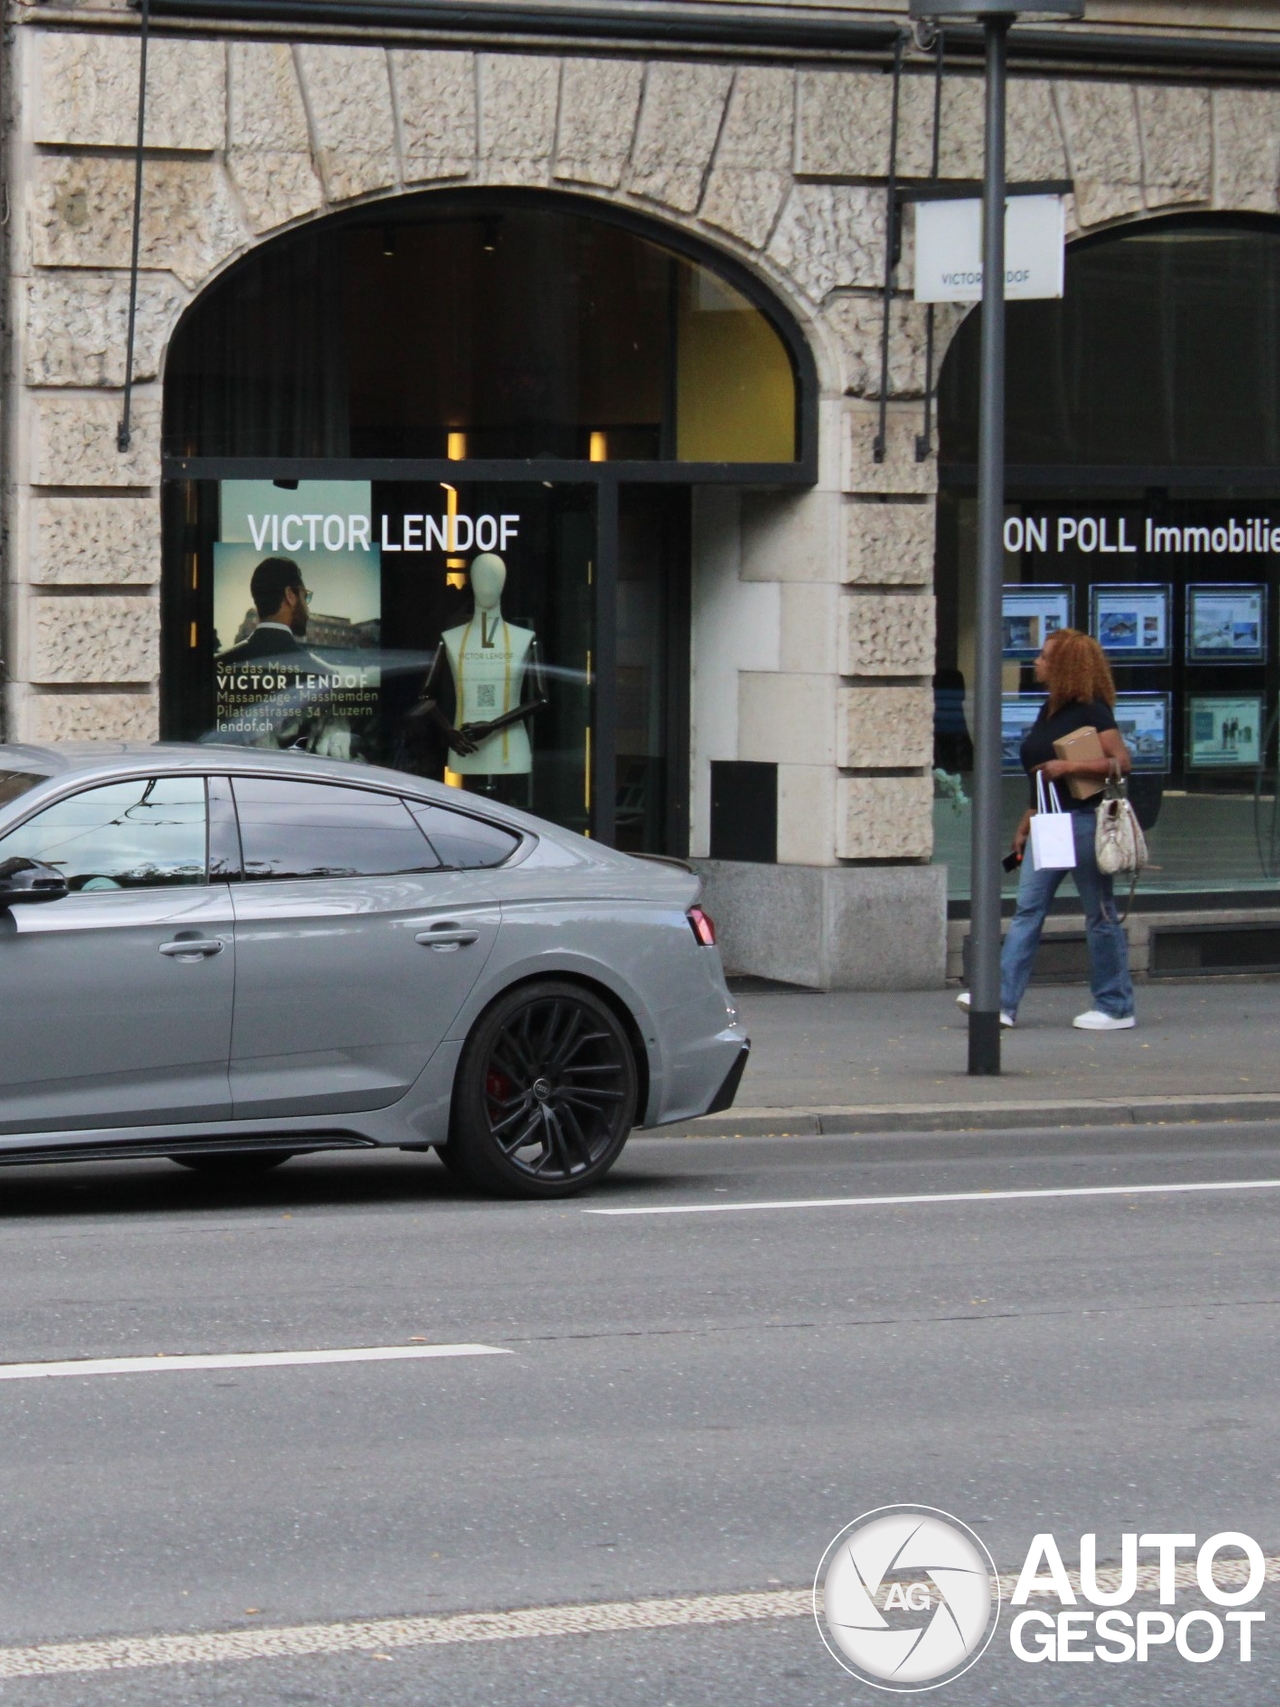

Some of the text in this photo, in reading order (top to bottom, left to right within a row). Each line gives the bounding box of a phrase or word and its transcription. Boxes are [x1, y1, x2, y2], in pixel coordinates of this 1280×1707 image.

[248, 514, 520, 551] VICTOR LENDOF
[1058, 517, 1137, 553] POLL
[216, 661, 304, 674] Sei das Mass.
[216, 674, 368, 690] VICTOR LENDOF
[216, 689, 379, 706] Massanzüge Masshemden
[216, 704, 374, 718] Pilatusstrasse 34 Luzern
[216, 718, 274, 733] lendof.ch
